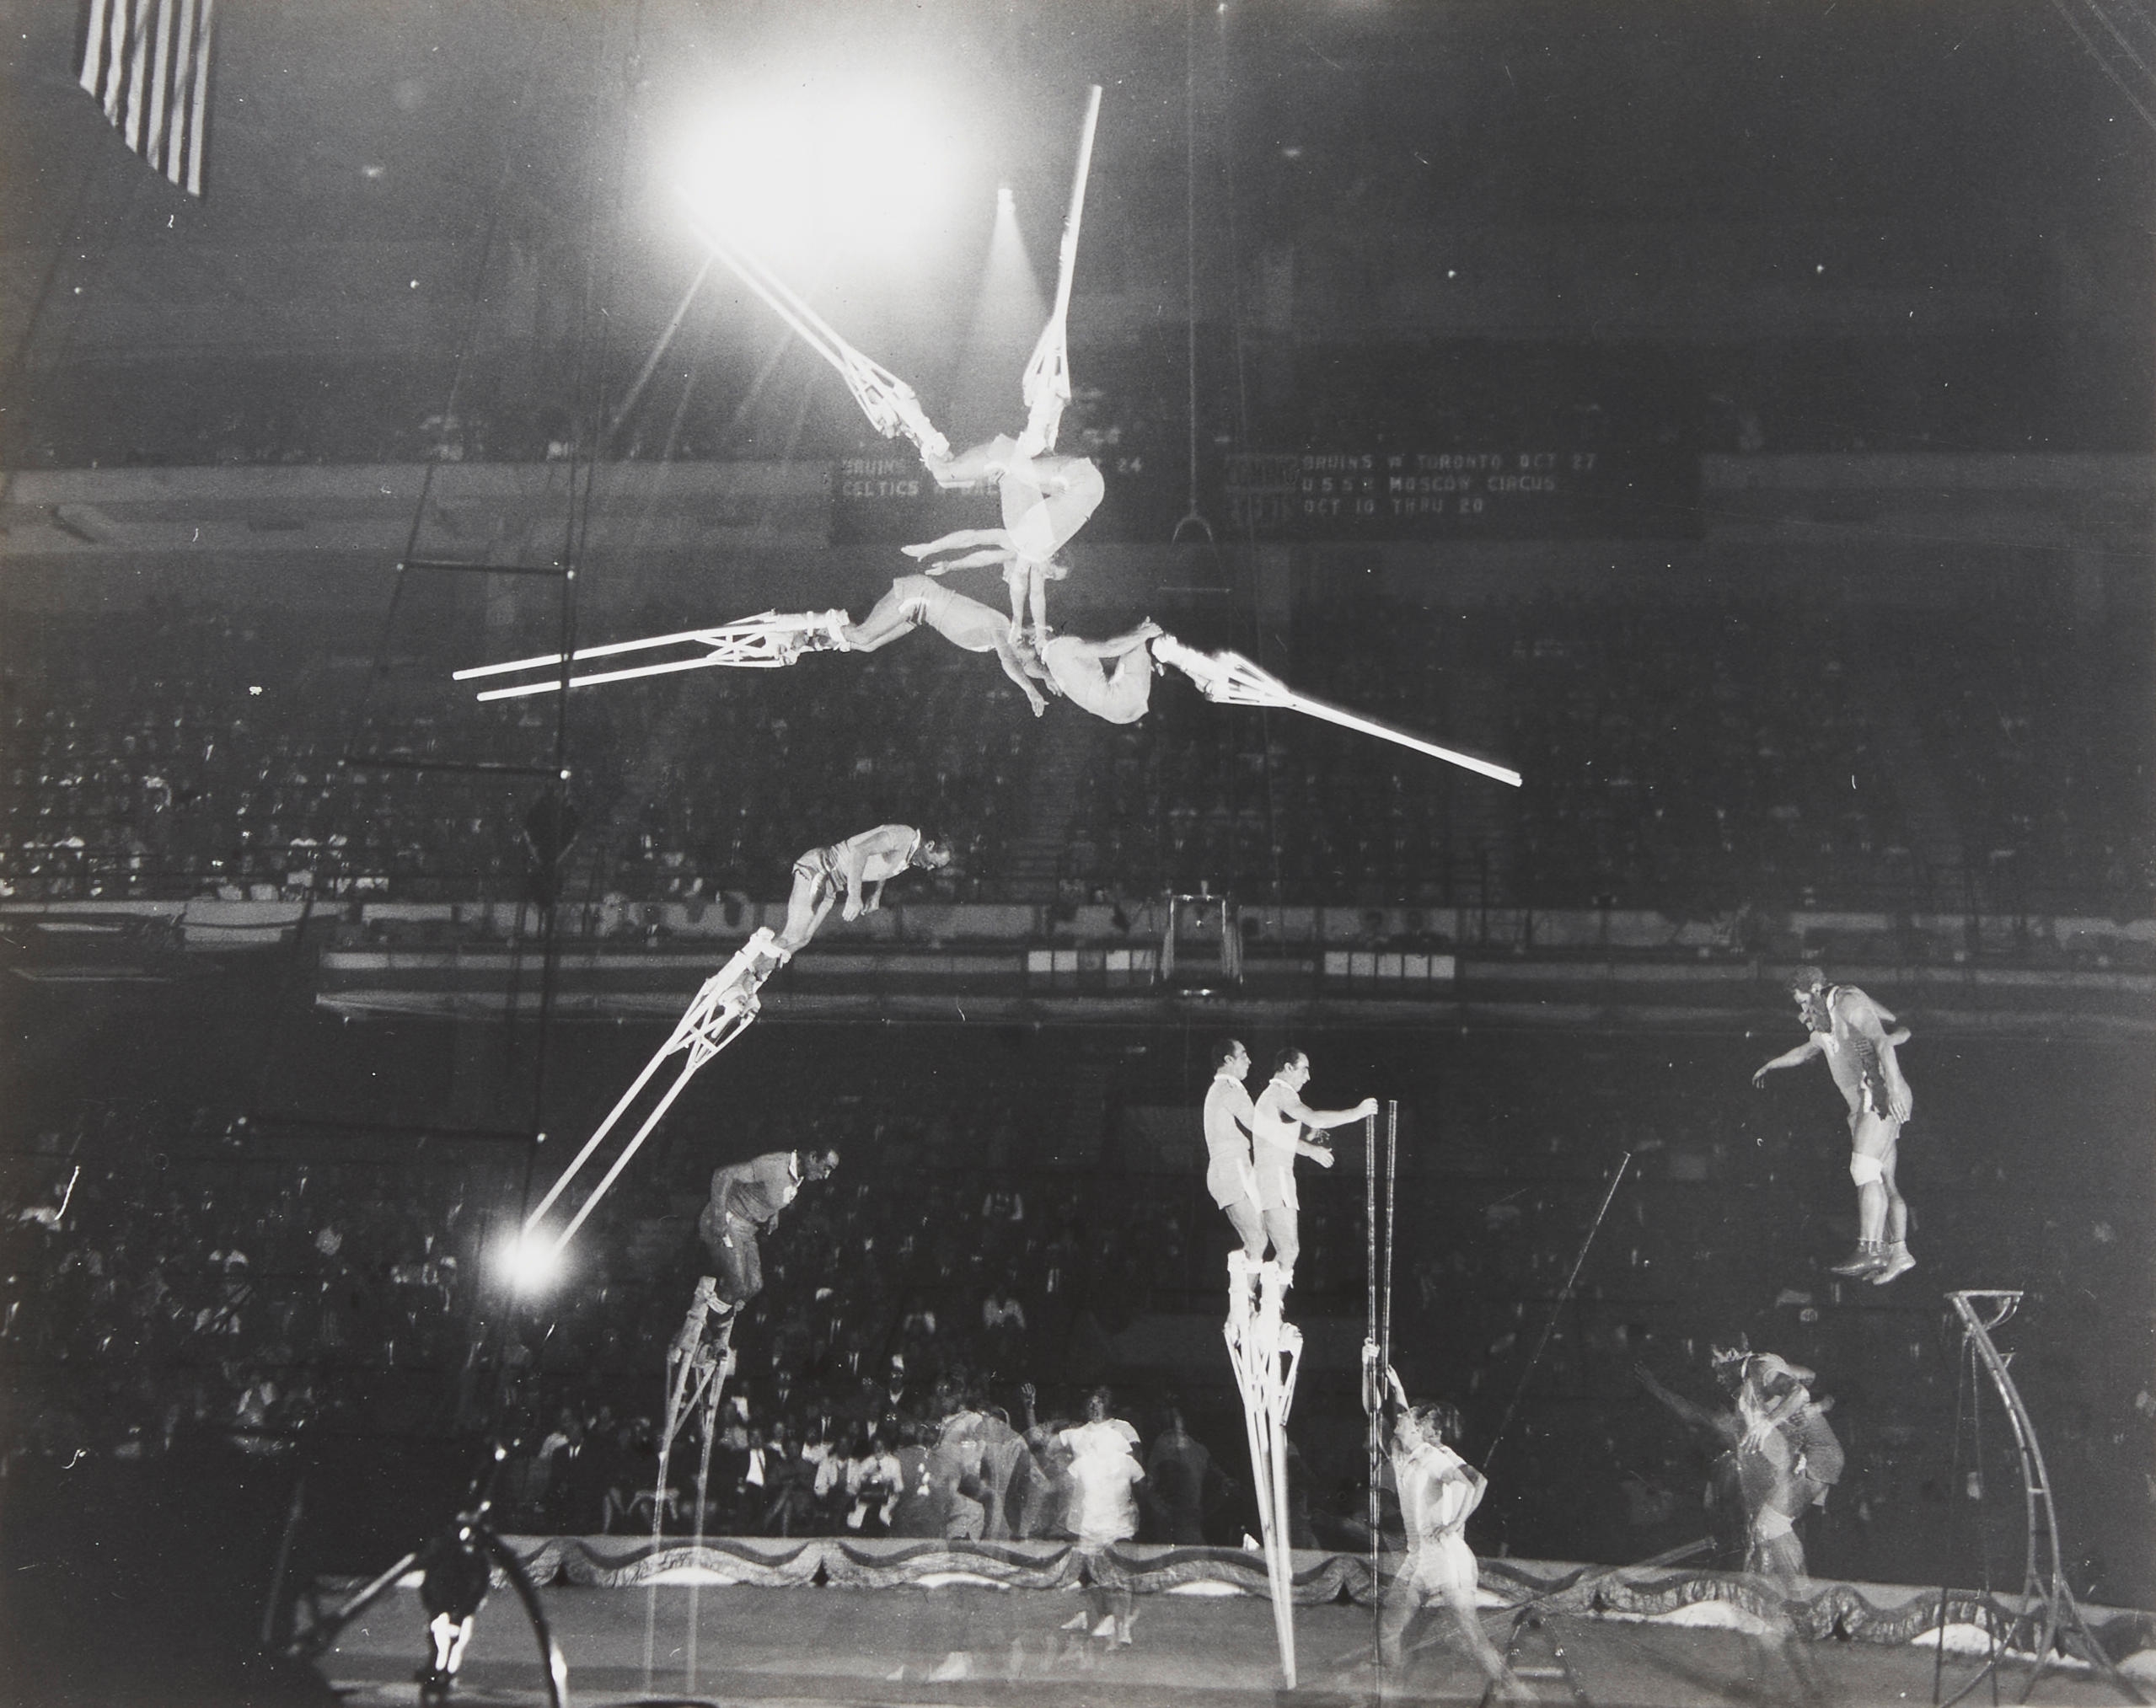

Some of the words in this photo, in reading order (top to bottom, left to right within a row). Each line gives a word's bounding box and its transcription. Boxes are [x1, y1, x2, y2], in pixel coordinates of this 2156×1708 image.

[1117, 457, 1143, 473] 24
[1301, 454, 1372, 470] BRUINS
[1417, 453, 1502, 470] TORONTO
[1520, 453, 1555, 469] OCT
[1573, 453, 1597, 470] 27
[843, 480, 920, 497] CELTICS
[1389, 476, 1471, 493] MOSCOW
[1487, 475, 1556, 492] CIRCUS
[1304, 499, 1340, 515] OCT
[1355, 499, 1375, 514] 10
[1392, 497, 1443, 515] THRU
[1459, 497, 1483, 514] 20
